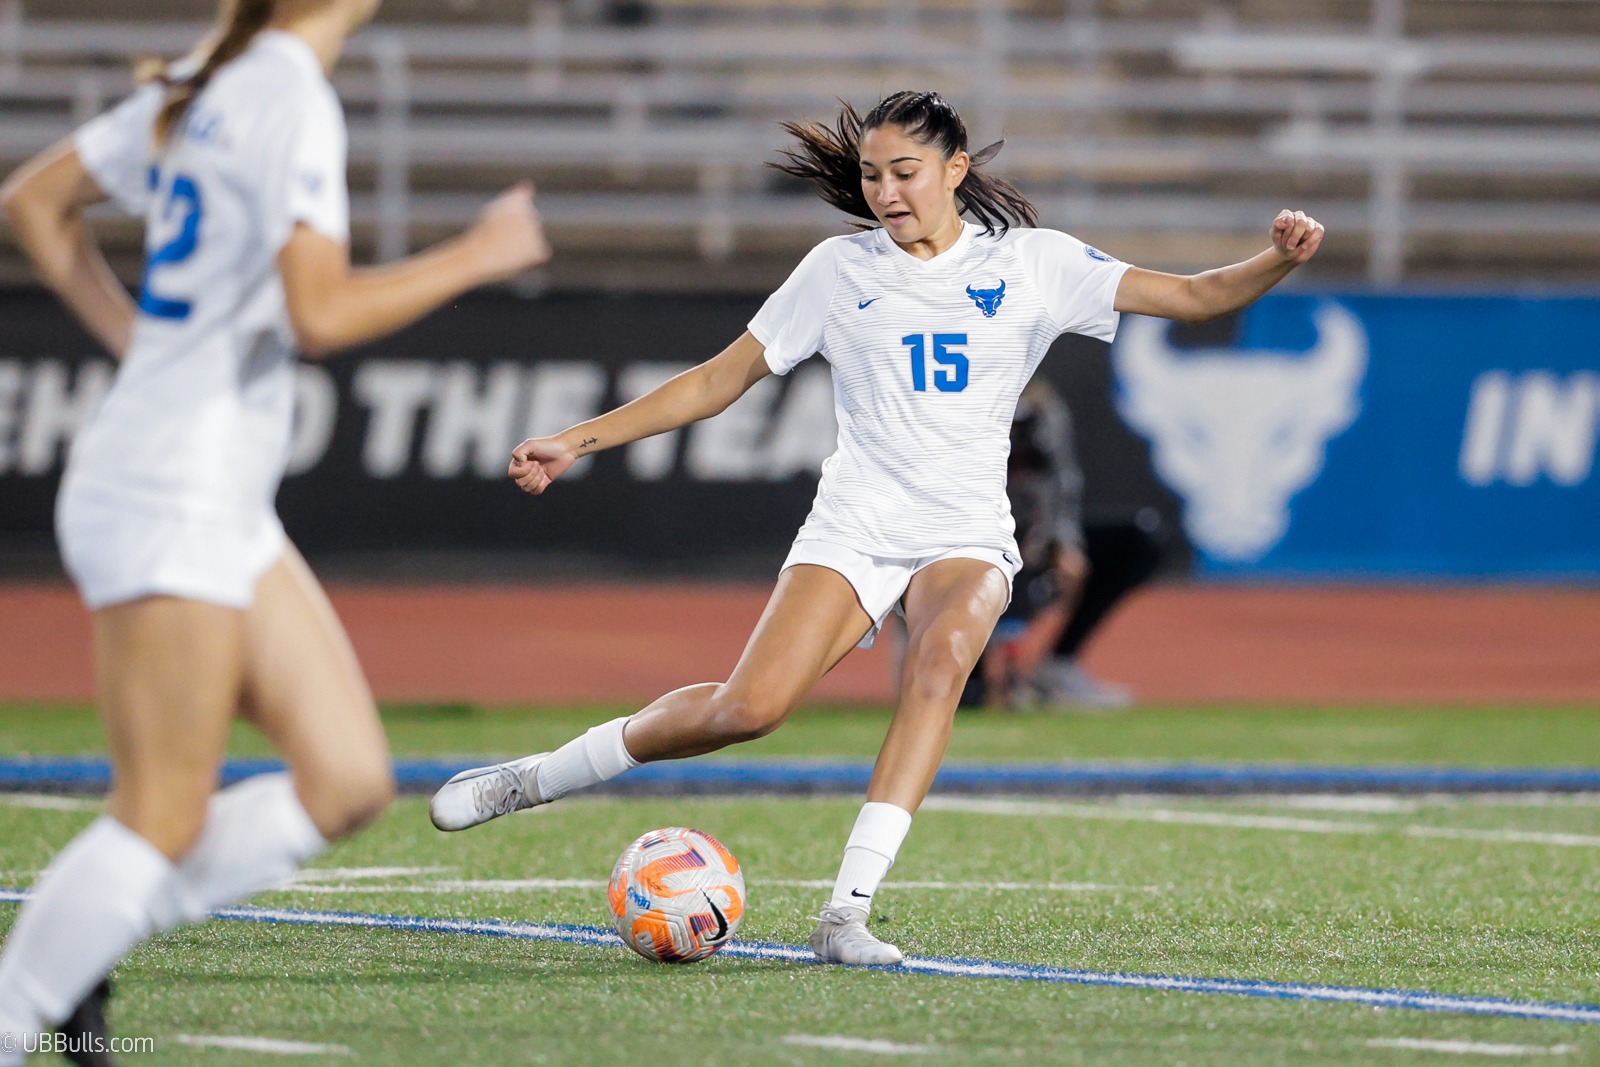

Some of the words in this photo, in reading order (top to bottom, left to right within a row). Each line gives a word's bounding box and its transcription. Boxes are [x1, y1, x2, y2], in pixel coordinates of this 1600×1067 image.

[142, 165, 203, 320] 2
[353, 359, 604, 481] THE
[615, 361, 838, 482] TEA
[901, 332, 970, 393] 15
